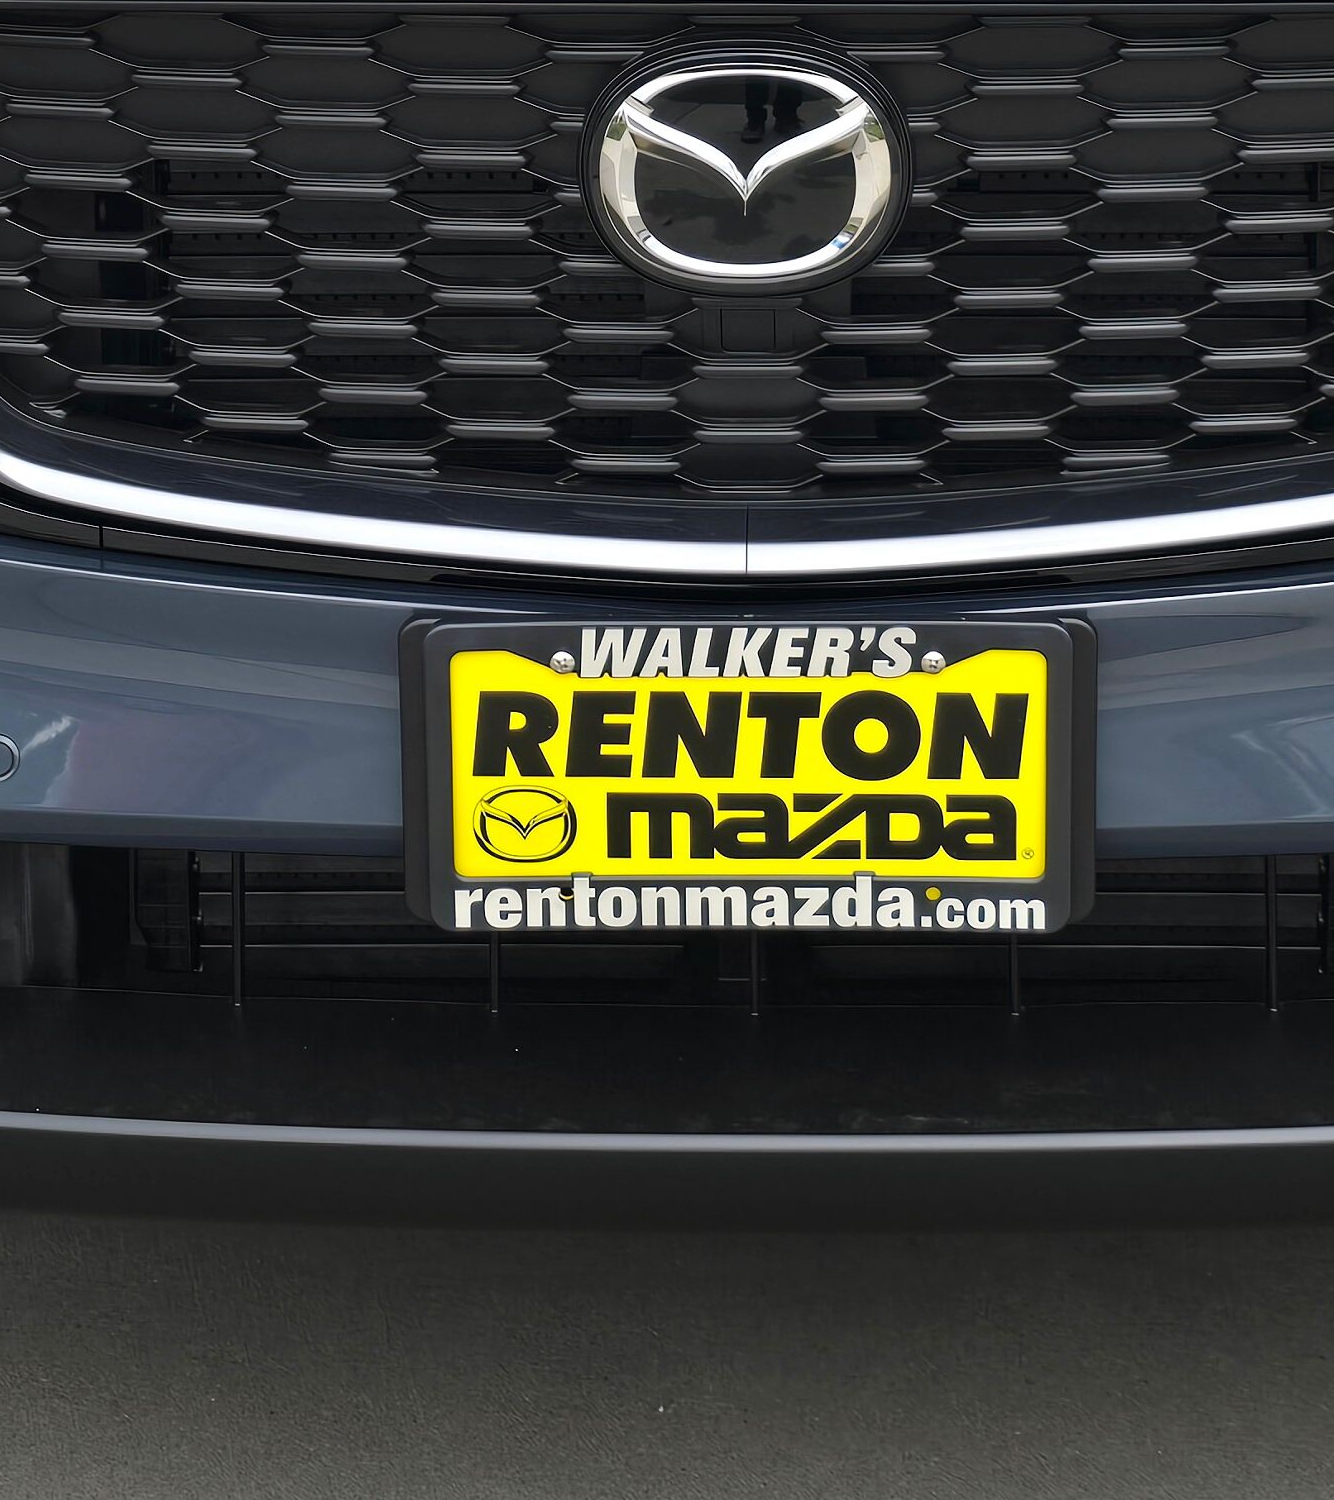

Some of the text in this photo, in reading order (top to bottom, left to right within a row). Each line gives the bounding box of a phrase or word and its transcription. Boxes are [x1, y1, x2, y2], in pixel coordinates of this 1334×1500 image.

[580, 627, 918, 678] WALKER'S
[472, 689, 1030, 782] RENTON
[606, 791, 1019, 861] mazda
[454, 875, 1047, 931] rentonmazda.com
